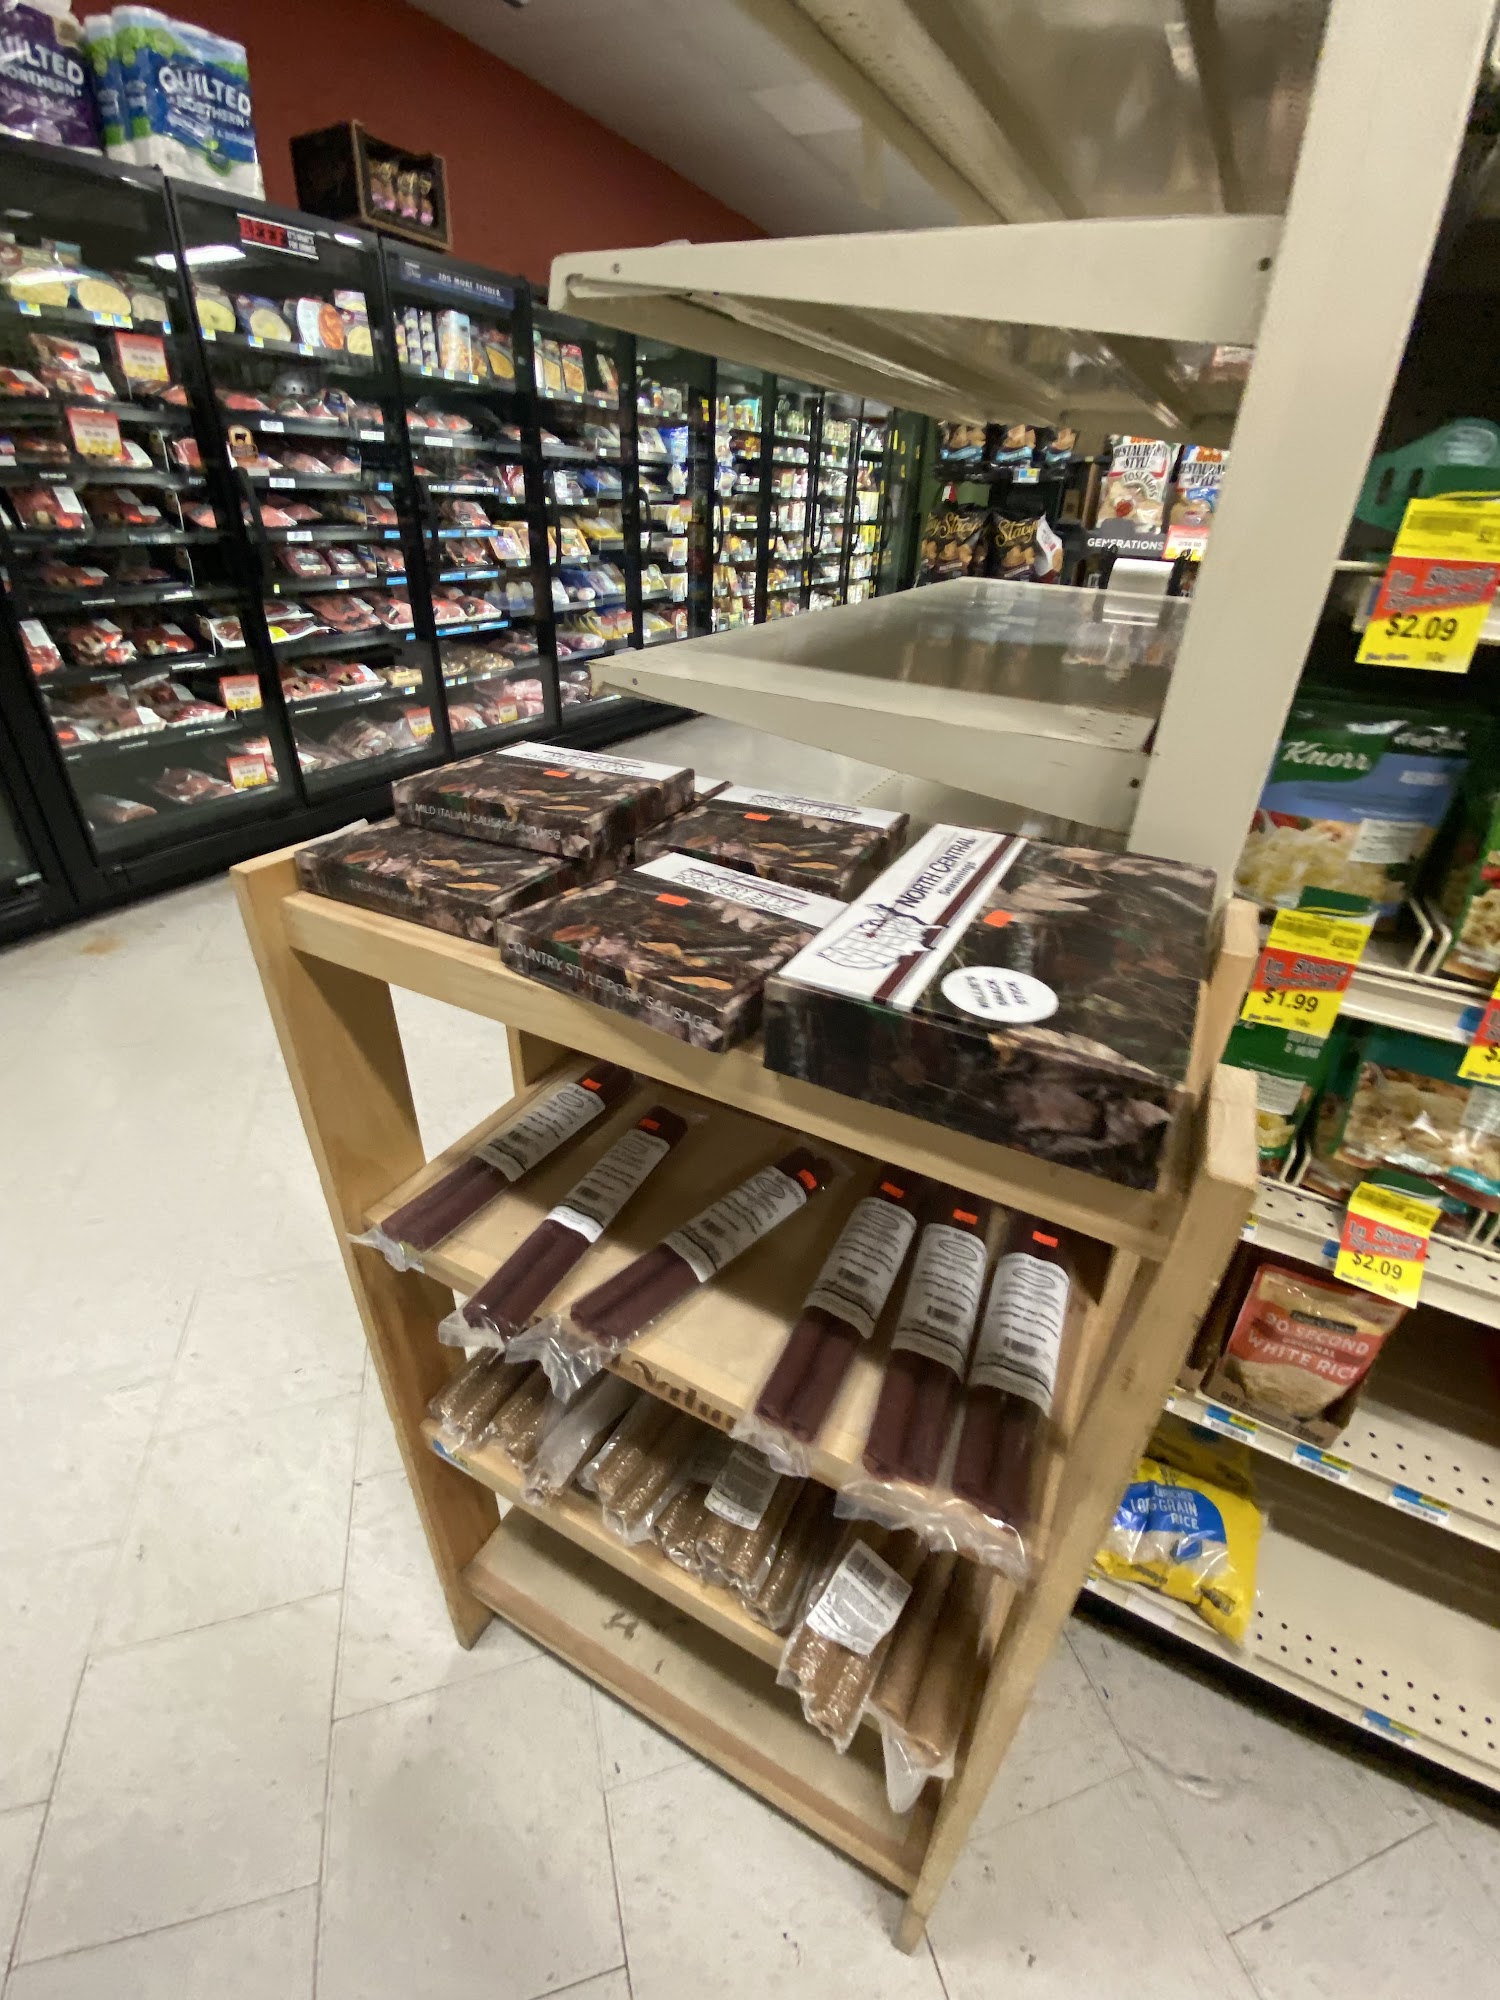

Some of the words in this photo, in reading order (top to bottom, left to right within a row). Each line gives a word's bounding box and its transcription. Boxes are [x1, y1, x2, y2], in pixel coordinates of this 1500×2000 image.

[0, 33, 85, 86] UILTED
[0, 64, 76, 98] ORTHERN
[158, 66, 252, 117] QUILTED
[1087, 537, 1165, 551] GENERATIONS
[1386, 612, 1458, 641] $2.09
[1282, 740, 1371, 771] Knorr
[414, 803, 436, 815] MILD
[437, 807, 471, 823] ITALIAN
[895, 871, 942, 909] NORTH
[929, 836, 977, 873] CENTRAL
[937, 861, 977, 897] Seasonings
[672, 874, 713, 891] PORK
[714, 887, 790, 914] SAUSAGE
[507, 941, 564, 972] COUNTRY
[564, 962, 602, 988] STYLE
[1262, 986, 1319, 1014] $1.99
[1351, 1249, 1403, 1280] $2.09
[1248, 1330, 1313, 1367] WHITE
[1296, 1326, 1370, 1355] SECOND
[1158, 1499, 1199, 1518] GRAIN
[1170, 1512, 1200, 1530] RICE
